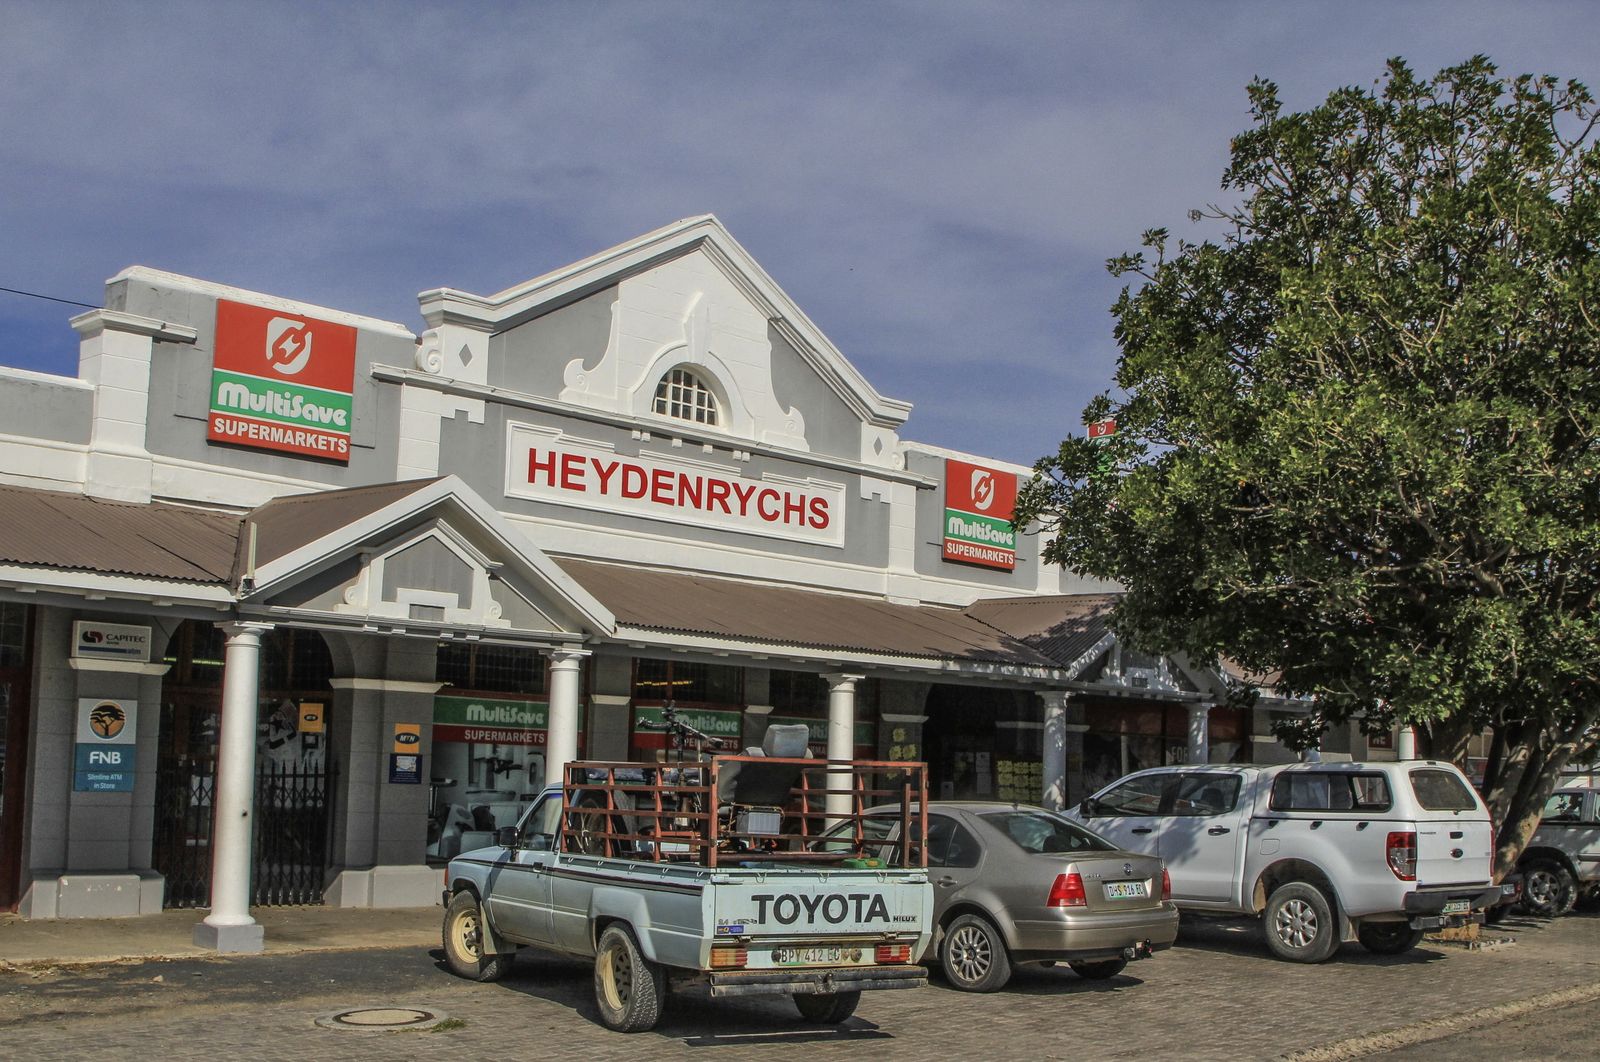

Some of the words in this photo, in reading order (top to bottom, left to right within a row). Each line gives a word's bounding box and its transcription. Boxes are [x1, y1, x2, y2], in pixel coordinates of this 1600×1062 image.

[217, 381, 347, 427] MultiSave
[213, 417, 348, 454] SUPERMARKETS
[527, 447, 830, 530] HEYDENRYCHS
[948, 516, 1014, 546] MultiSave
[946, 543, 1014, 564] SUPERMARKETS
[105, 633, 146, 643] CAPITEC
[466, 704, 545, 725] MultiSave
[464, 729, 545, 744] SUPERMARKETS
[89, 751, 122, 764] FNB
[751, 893, 890, 925] TOYOTA
[781, 949, 801, 963] BPY
[804, 948, 824, 962] 412
[827, 946, 840, 961] EC
